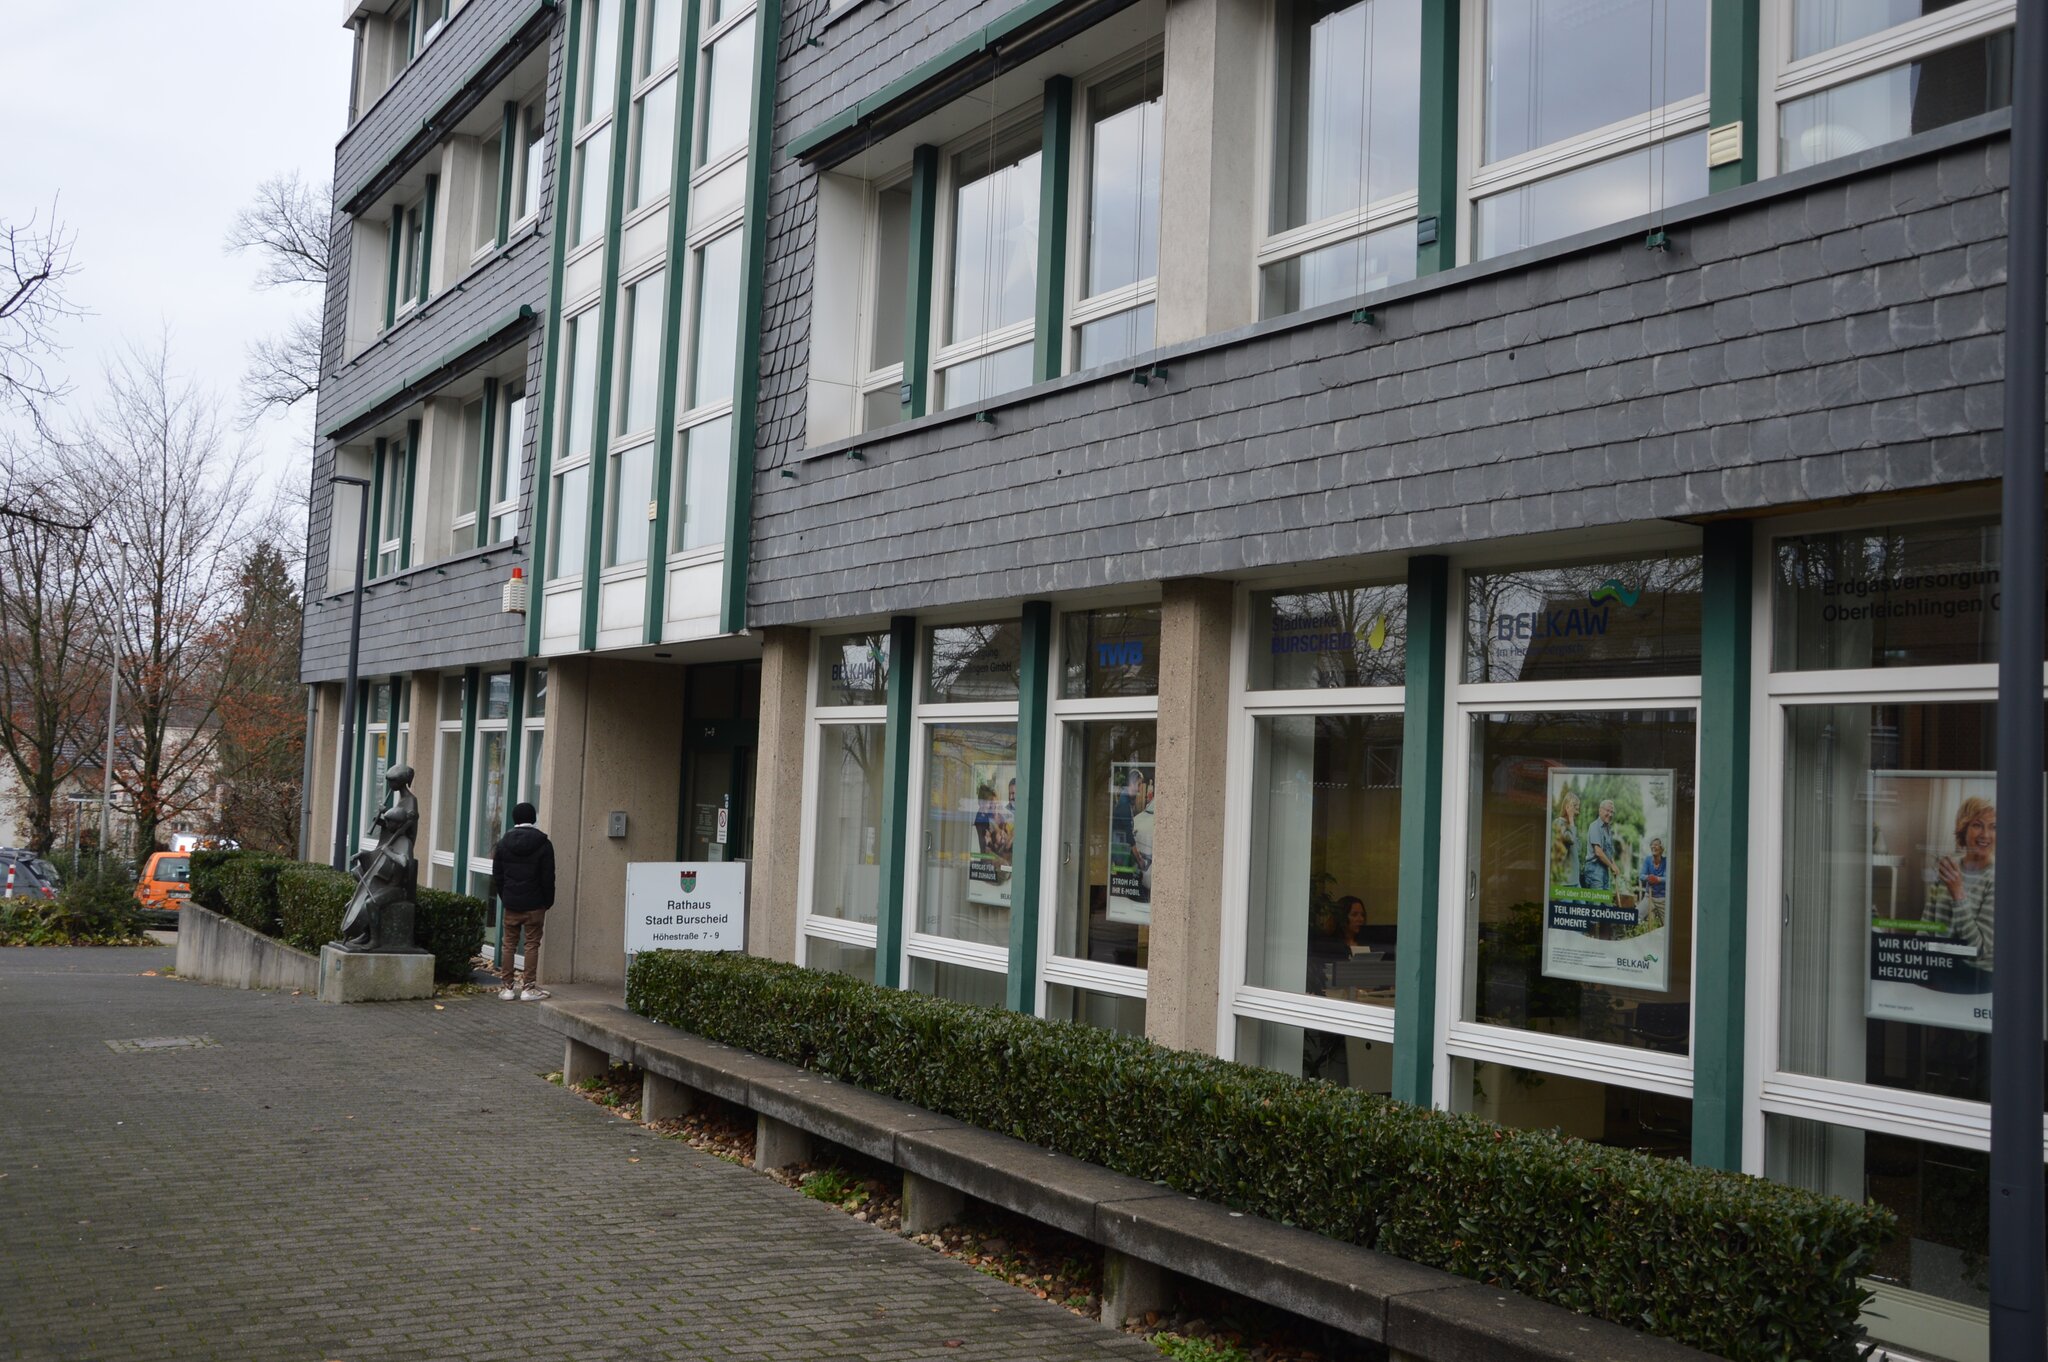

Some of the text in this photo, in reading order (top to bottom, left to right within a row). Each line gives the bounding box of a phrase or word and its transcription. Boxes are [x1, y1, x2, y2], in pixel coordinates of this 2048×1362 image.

[1824, 569, 1999, 597] Erdgasversorgun
[1823, 597, 1983, 622] Oberleichlingen
[1272, 611, 1339, 632] Stadtwerke
[1497, 606, 1609, 641] BELKAW
[1271, 631, 1353, 654] BURSCHEID
[1096, 640, 1144, 667] TWB
[989, 661, 1012, 673] GmbH
[1112, 877, 1139, 887] STROM FÜR
[1121, 887, 1140, 896] E-MOBIL
[1554, 888, 1566, 897] Seit
[1566, 889, 1579, 897] über
[1580, 890, 1592, 899] 100
[667, 900, 711, 910] Rathaus
[645, 914, 728, 925] Stadt Burscheid
[1554, 905, 1635, 921] TEIL IHRER SCHÖNSTEN
[1553, 917, 1588, 928] MOMENTE
[652, 931, 698, 941] Höhestraße
[703, 931, 708, 939] 7
[714, 931, 719, 939] 9
[1878, 937, 1900, 949] WIR
[1616, 957, 1650, 970] BELKAW
[1878, 951, 1953, 969] UNS UM IHRE
[1878, 966, 1929, 981] HEIZUNG
